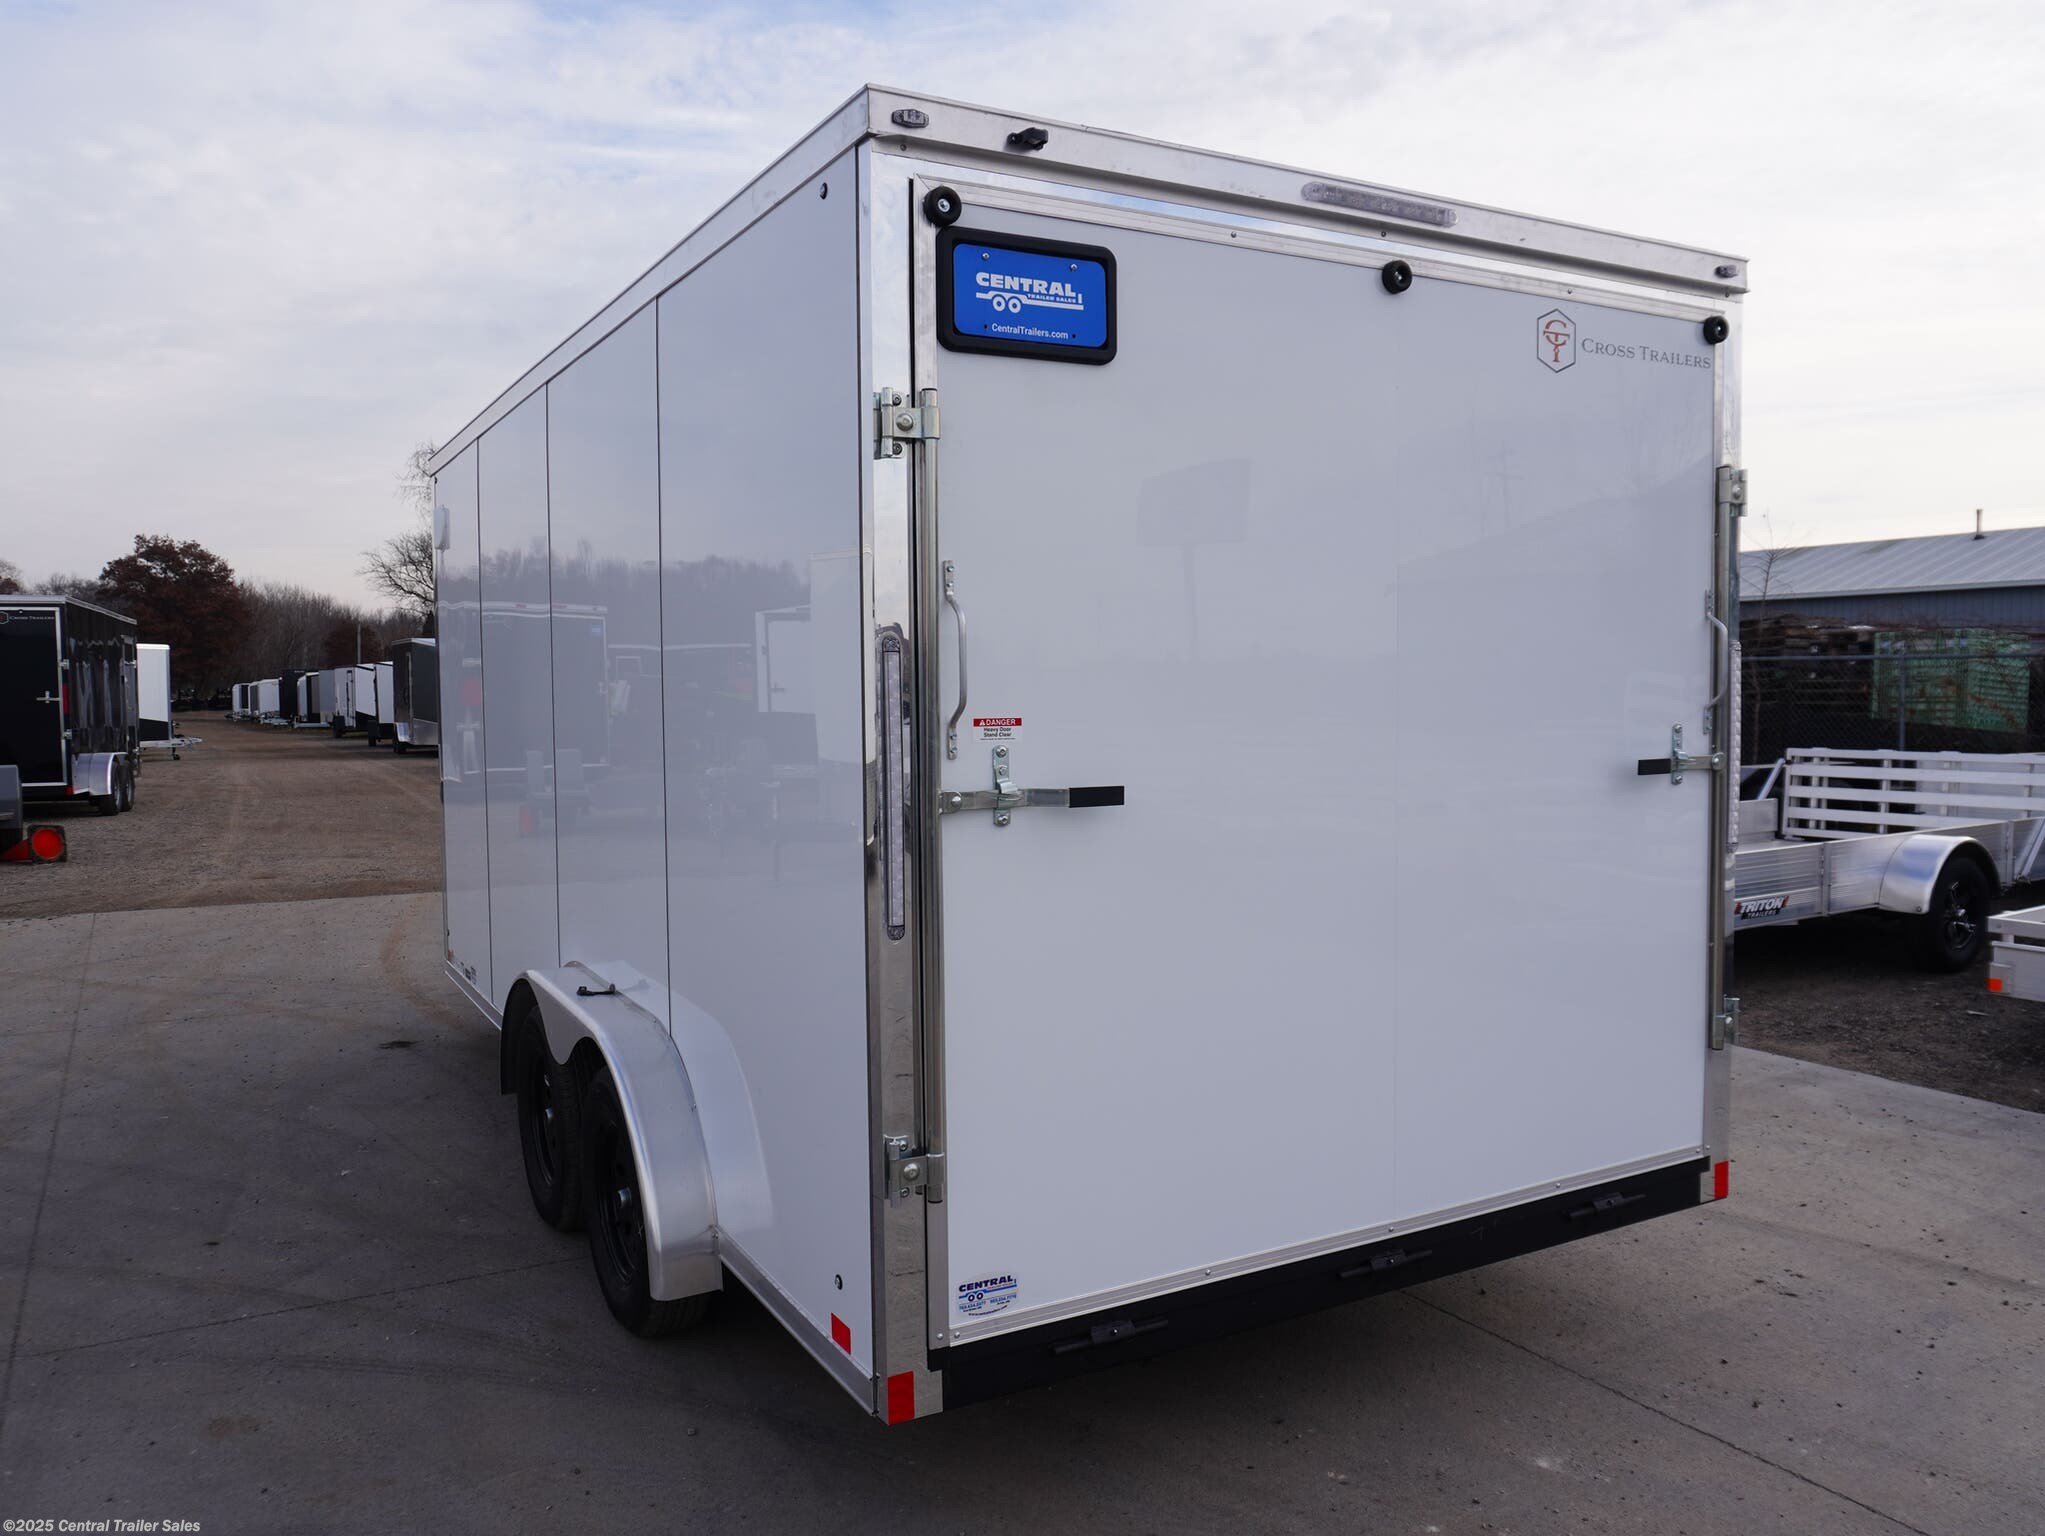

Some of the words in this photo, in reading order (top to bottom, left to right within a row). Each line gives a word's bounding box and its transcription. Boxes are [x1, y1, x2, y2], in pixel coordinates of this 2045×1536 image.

[975, 271, 1077, 297] CENTRAL
[1027, 293, 1055, 302] TRAILER
[991, 323, 1069, 340] CentralTrailers.com
[1581, 338, 1636, 359] CROSS
[1639, 346, 1712, 369] TRAILERS
[985, 718, 1016, 726] DANGER
[1741, 898, 1783, 913] TRITON
[958, 1275, 1013, 1292] CENTRAL
